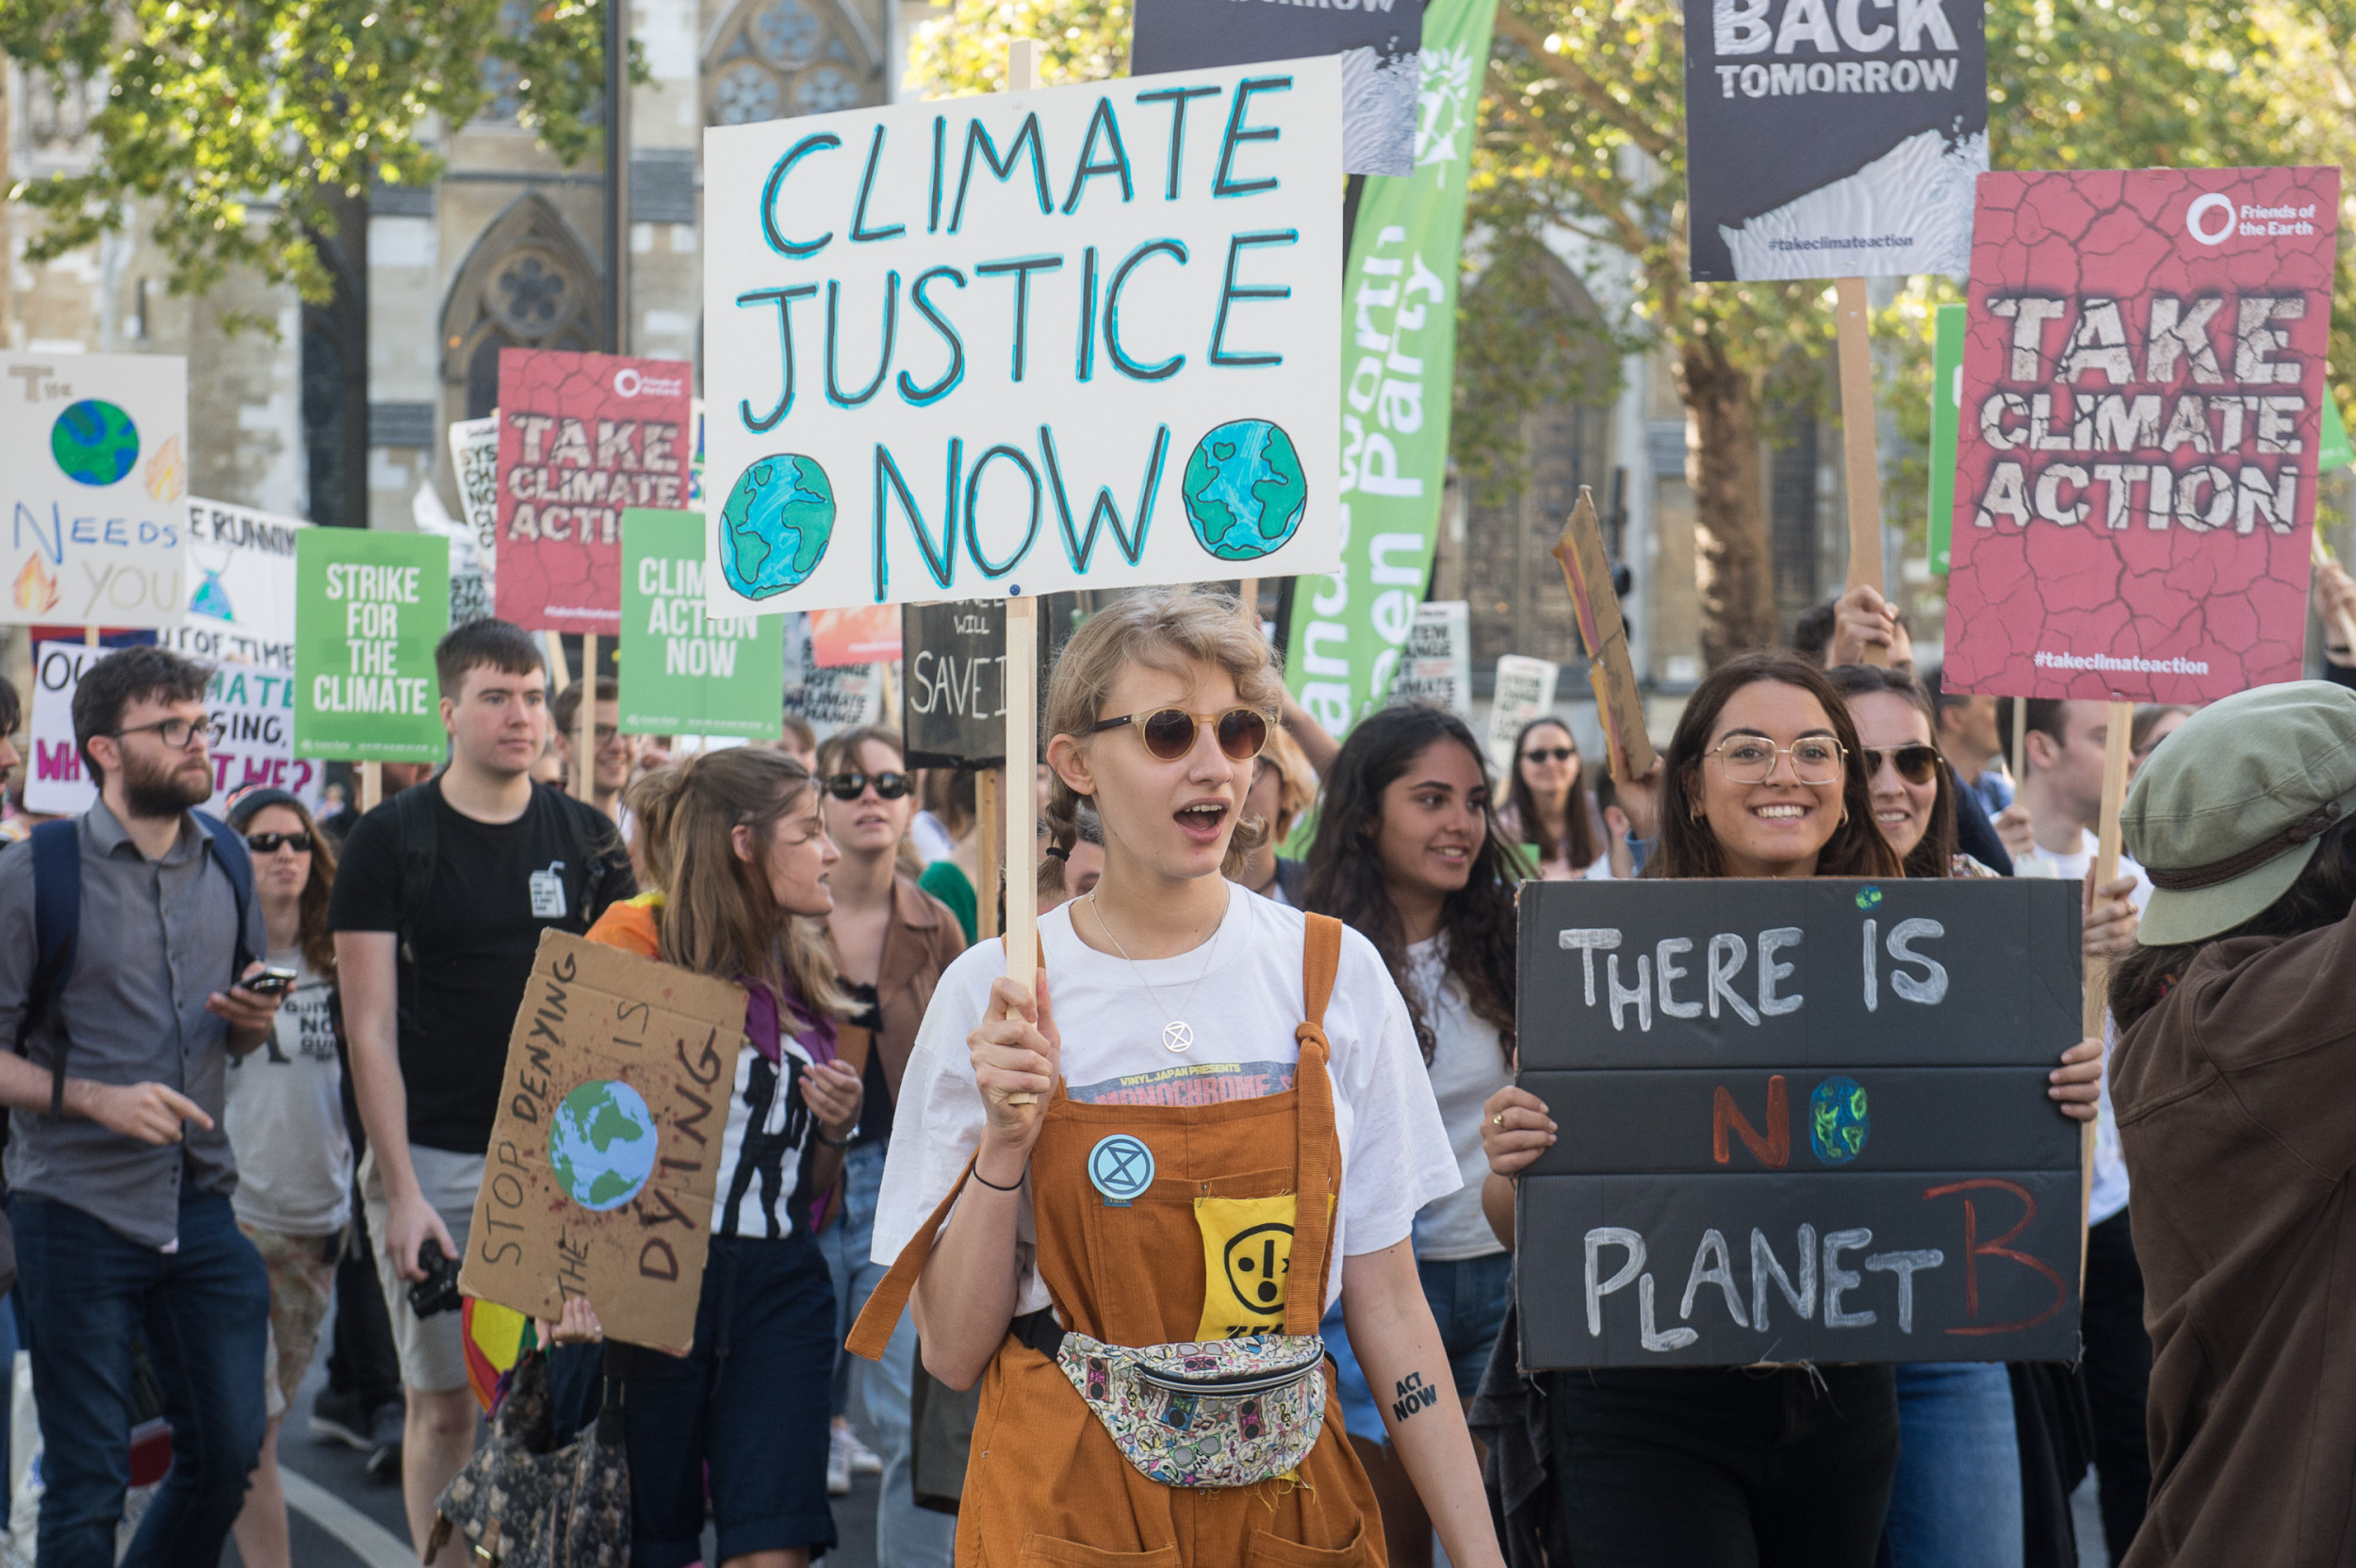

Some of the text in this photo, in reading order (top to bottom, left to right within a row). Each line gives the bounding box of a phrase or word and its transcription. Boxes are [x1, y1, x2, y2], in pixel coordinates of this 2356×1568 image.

[1712, 0, 1959, 56] BACK
[1714, 57, 1959, 98] TOMORROW
[761, 75, 1294, 259] CLIMATE
[2239, 220, 2314, 236] the Earth
[2240, 204, 2316, 219] Friends of
[1767, 233, 1914, 253] #takeclimateaction
[736, 228, 1300, 433] JUSTICE
[1987, 297, 2306, 384] TAKE
[1359, 252, 1445, 498] Party
[508, 414, 679, 471] TAKE
[1980, 392, 2305, 454] CLIMATE
[460, 444, 497, 466] SYS
[468, 487, 497, 505] NO
[508, 466, 681, 509] CLIMATE
[1973, 462, 2299, 534] ACTION
[189, 507, 297, 556] E RUNNIN
[507, 503, 623, 545] ACTI
[874, 424, 1170, 603] NOW
[81, 561, 179, 618] YOU
[325, 562, 420, 603] STRIKE
[638, 556, 706, 597] CLIM
[346, 600, 398, 639] FOR
[953, 613, 990, 635] WILL
[195, 630, 223, 657] OF
[232, 635, 295, 670] TIME
[346, 639, 398, 677] THE
[666, 636, 738, 678] NOW
[2034, 650, 2209, 676] #takeclimateaction
[313, 674, 429, 715] CLIMATE
[909, 649, 991, 720] SAVE
[37, 739, 93, 781] WH
[1559, 926, 1804, 1032] THERE
[301, 1018, 332, 1035] NO
[1120, 1062, 1242, 1086] VINYL JAPAN PRESENTS
[482, 1141, 531, 1266] STOP
[512, 952, 577, 1124] DENYING
[557, 1000, 649, 1305] THE IS
[638, 1027, 724, 1282] DYING
[1583, 1178, 2067, 1352] PLANET B
[1392, 1383, 1438, 1422] NOW
[1396, 1371, 1423, 1398] ACT
